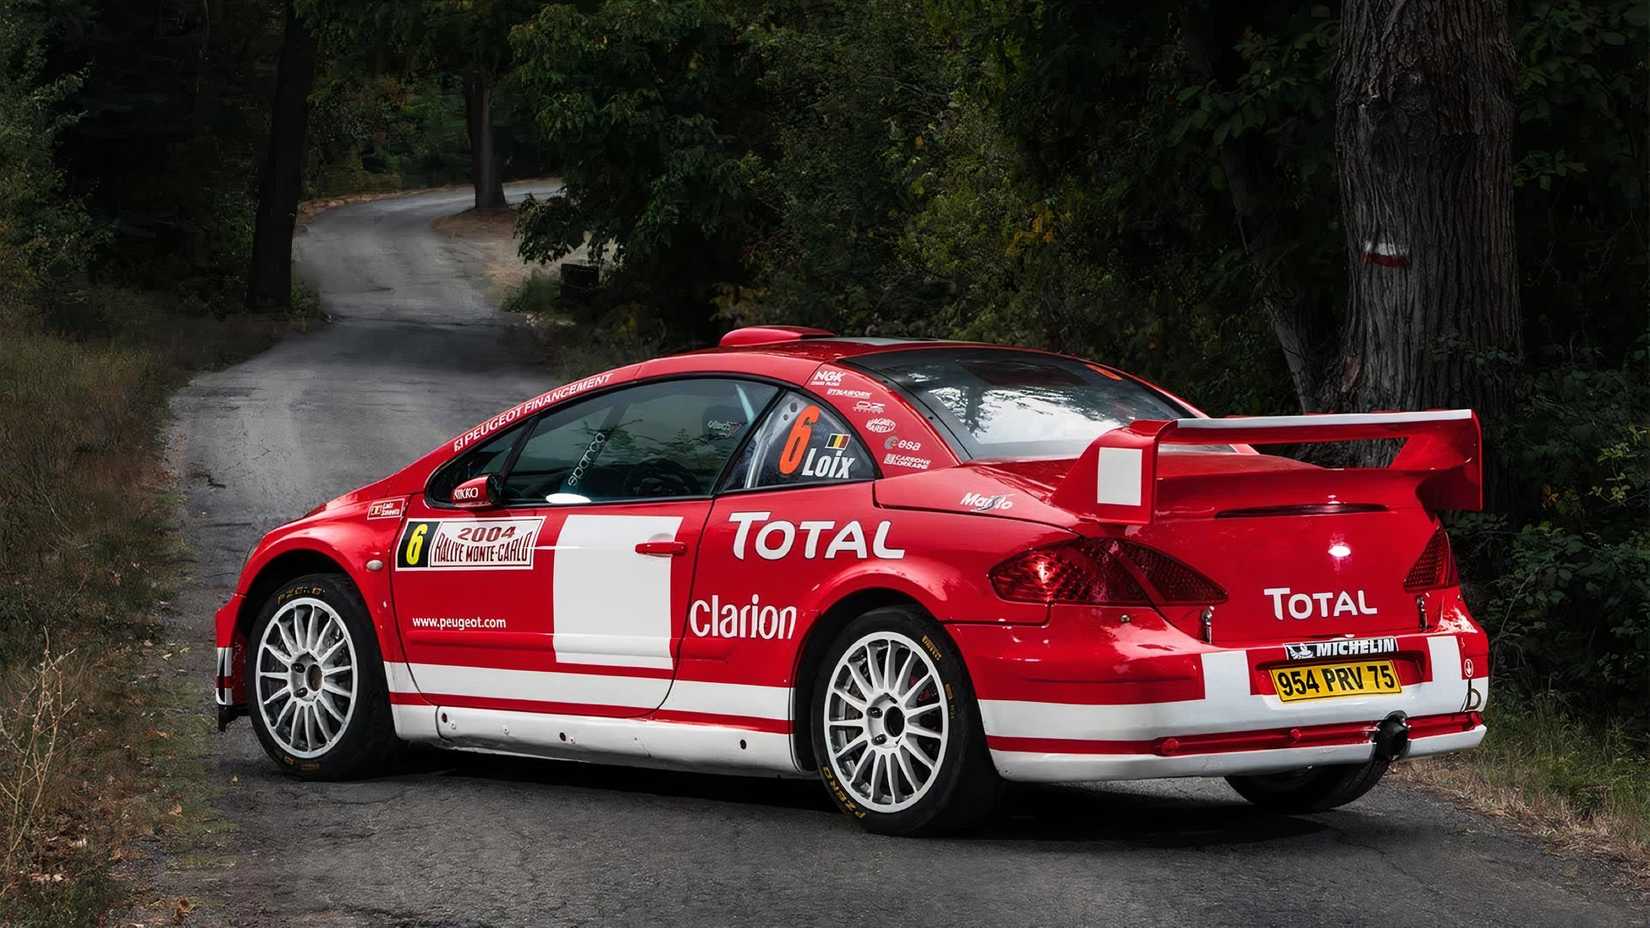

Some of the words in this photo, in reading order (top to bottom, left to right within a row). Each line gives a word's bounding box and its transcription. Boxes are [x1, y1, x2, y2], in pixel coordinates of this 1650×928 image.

[814, 371, 845, 382] NGK
[464, 407, 525, 446] PEUGEOT
[524, 373, 613, 414] FINANCEMENT
[779, 404, 821, 475] 6
[898, 439, 921, 451] esa
[568, 432, 605, 487] sparco
[801, 448, 855, 479] Loix
[406, 523, 429, 565] 6
[434, 532, 464, 562] RALLYE
[466, 531, 533, 562] MONTE-CARLO
[457, 526, 516, 543] 2004
[412, 616, 507, 631] www.peugeot.com
[689, 593, 797, 640] Clarion
[1316, 638, 1395, 657] MICHELIN
[1277, 671, 1320, 697] 954
[1325, 667, 1367, 693] PRV
[1367, 664, 1395, 689] 75
